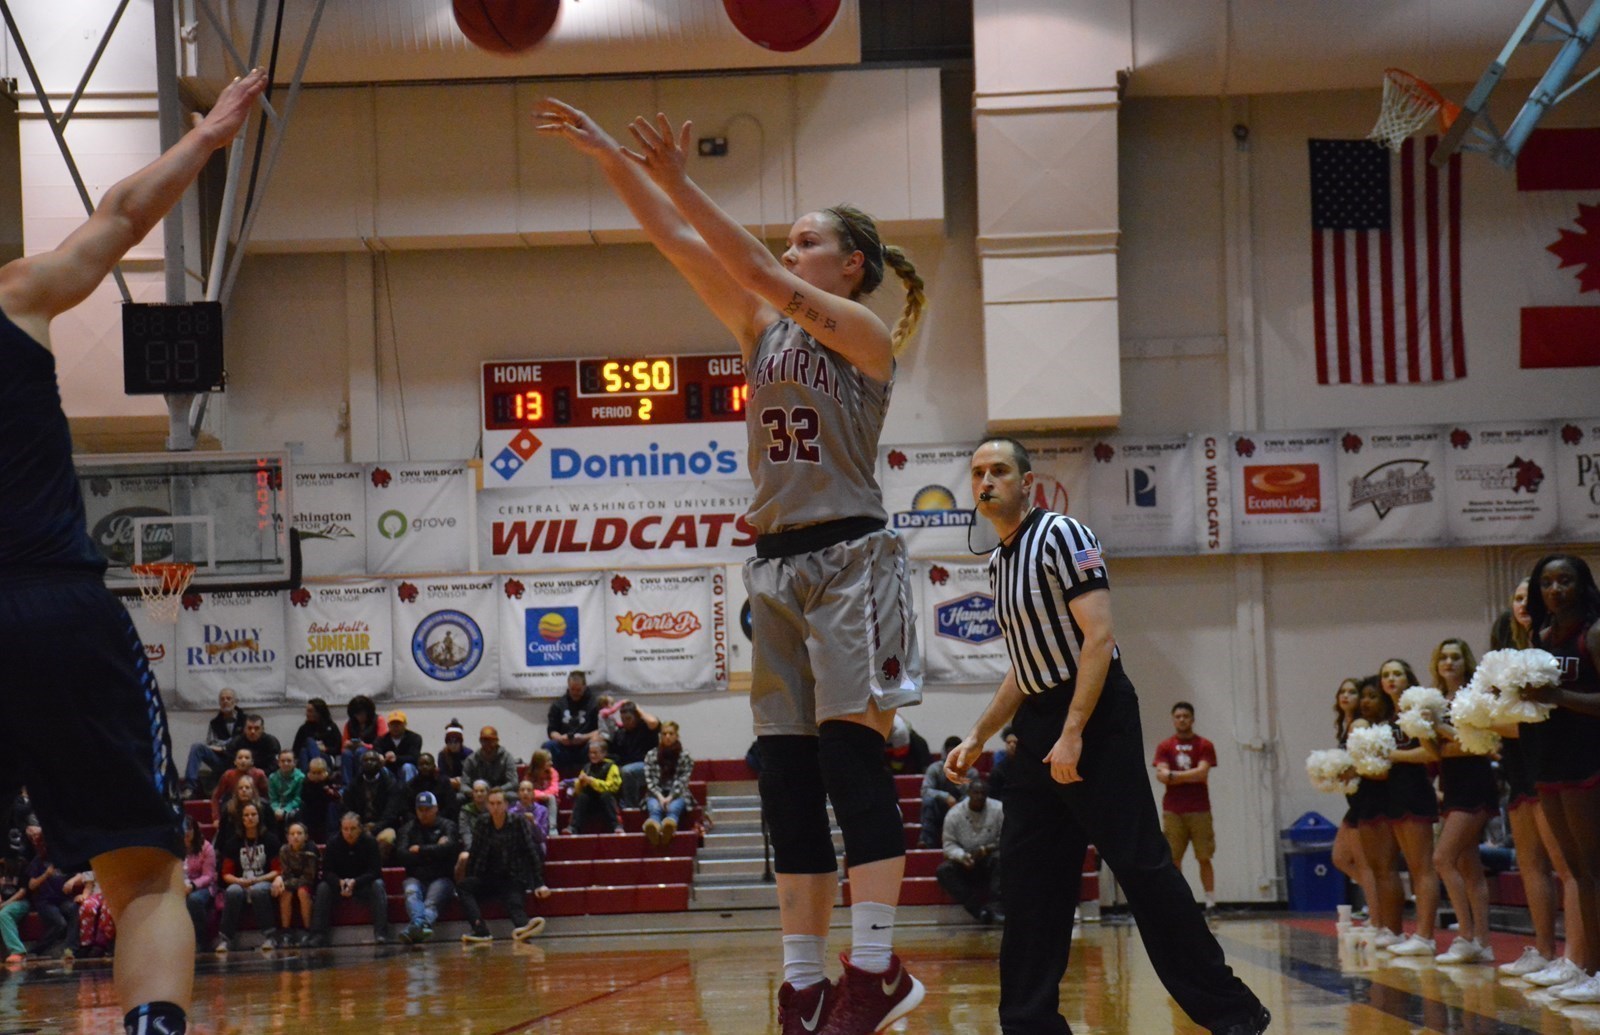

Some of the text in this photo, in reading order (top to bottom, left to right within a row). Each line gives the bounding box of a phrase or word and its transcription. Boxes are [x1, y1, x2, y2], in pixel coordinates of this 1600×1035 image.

[494, 365, 542, 383] HOME
[708, 358, 743, 377] GUE
[603, 360, 671, 392] 5:50
[515, 391, 543, 421] 13
[592, 405, 632, 419] PERIOD
[638, 398, 652, 420] 2
[760, 405, 822, 465] 32
[550, 440, 738, 480] Domino's
[939, 450, 974, 458] WILDCA
[320, 472, 360, 480] WILDCAT
[424, 468, 464, 477] WILDCAT
[1204, 437, 1220, 549] GO WILDCATS
[498, 504, 561, 516] CENTRAL
[569, 500, 666, 512] WASHINGTON
[1248, 494, 1318, 510] EconoLodge
[412, 517, 457, 532] grove
[897, 512, 973, 528] Days Inn
[491, 513, 758, 556] WILDCATS
[320, 586, 387, 596] CWU WILDCAT
[428, 583, 493, 592] CWU WILDCAT
[558, 579, 600, 587] WILDCAT
[236, 590, 279, 599] WILDCAT
[940, 606, 995, 627] Hampt
[307, 619, 370, 634] Bob Hall's
[712, 574, 726, 682] GO WILDCATS
[307, 633, 371, 653] SUNFAIR
[528, 640, 577, 653] Comfort
[295, 652, 383, 670] CHEVROLET
[543, 652, 563, 661] INN
